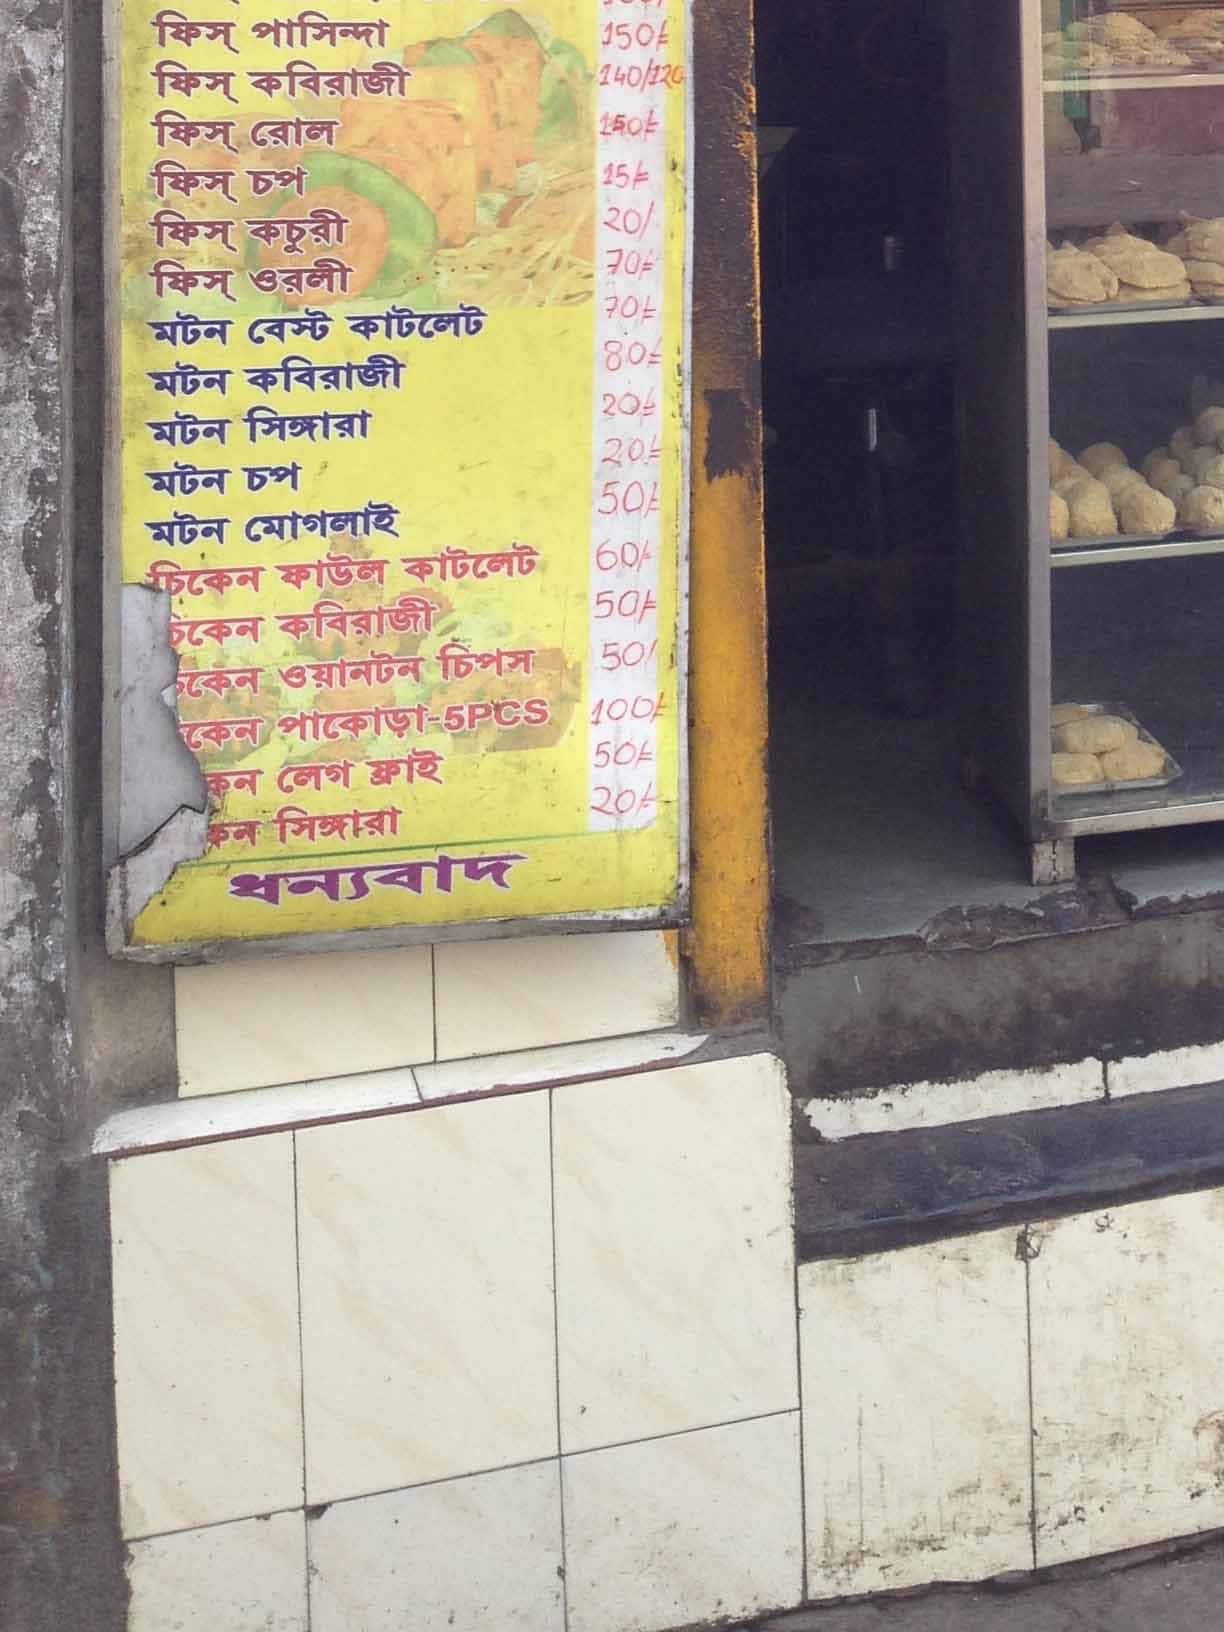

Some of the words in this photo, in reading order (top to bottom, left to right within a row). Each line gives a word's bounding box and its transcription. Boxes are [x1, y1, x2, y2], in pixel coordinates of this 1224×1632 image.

[151, 9, 239, 54] ফিস্
[251, 10, 390, 48] পাসিন্দা
[150, 59, 239, 104] ফিস্
[247, 59, 411, 98] কবিরাজী
[150, 109, 239, 153] ফিস্
[247, 117, 339, 146] রোল
[150, 159, 238, 203] ফিস্
[247, 167, 307, 196] চপ
[150, 209, 237, 253] ফিস্
[246, 208, 350, 254] কচুরী
[149, 259, 236, 302] ফিস্
[249, 258, 353, 294] ওরলী
[147, 311, 234, 347] মটন
[248, 308, 333, 345] বেস্ট
[345, 303, 487, 340] কাটলেট
[147, 361, 233, 396] মটন
[244, 354, 407, 394] কবিরাজী
[146, 411, 232, 447] মটন
[243, 406, 372, 443] সিঙ্গারা
[146, 462, 232, 496] মটন
[242, 462, 302, 493] চপ
[145, 512, 231, 547] মটন
[245, 501, 400, 543] মোগলাই
[145, 560, 265, 598] চিকেন
[275, 551, 390, 591] ফাউল
[400, 542, 540, 583] কাটলেট
[275, 596, 438, 640] কবিরাজী
[278, 652, 426, 690] ওয়ানটন
[436, 642, 536, 681] চিপস
[277, 760, 354, 794] লেগ
[367, 748, 445, 785] ফ্রাই
[271, 805, 402, 844] সিঙ্গারা
[229, 854, 529, 907] ধন্যবাদ
